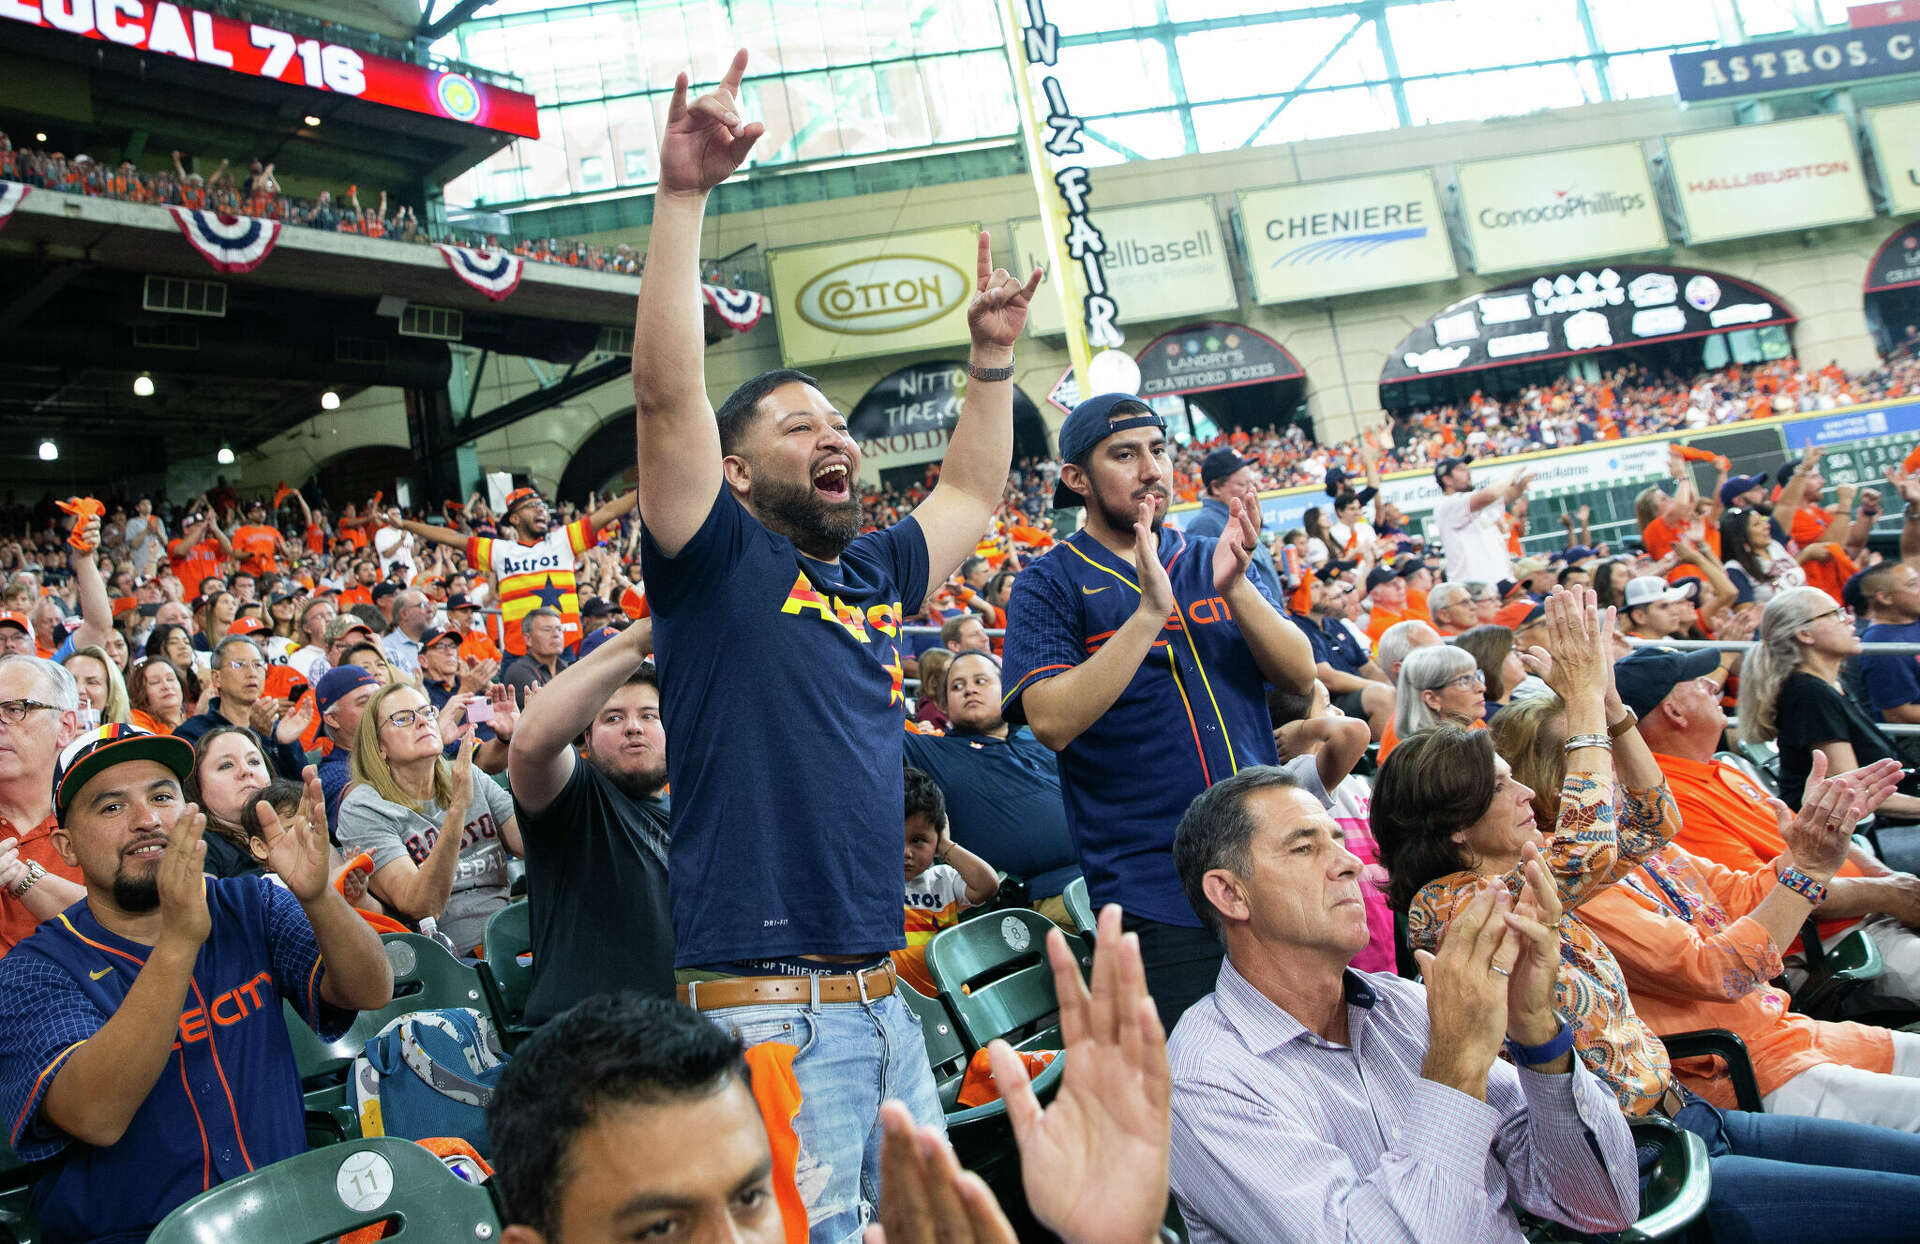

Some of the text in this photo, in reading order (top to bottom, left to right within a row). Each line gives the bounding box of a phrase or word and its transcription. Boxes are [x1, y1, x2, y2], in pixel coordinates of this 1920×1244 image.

[250, 24, 367, 97] 716
[1701, 41, 1868, 87] ASTROS
[1687, 161, 1850, 193] HALLIBURTON
[1265, 201, 1424, 242] CHENIERE
[1478, 189, 1646, 230] ConocoPhillips
[1055, 166, 1126, 348] FAIR
[818, 274, 944, 321] COTTON
[900, 368, 968, 397] NITTO
[1144, 370, 1227, 393] CRAWFORD
[861, 427, 943, 458] RNOLD
[504, 555, 559, 575] Astros
[764, 919, 789, 928] DRI-FIT
[1011, 927, 1022, 940] 8
[350, 1168, 378, 1197] 11
